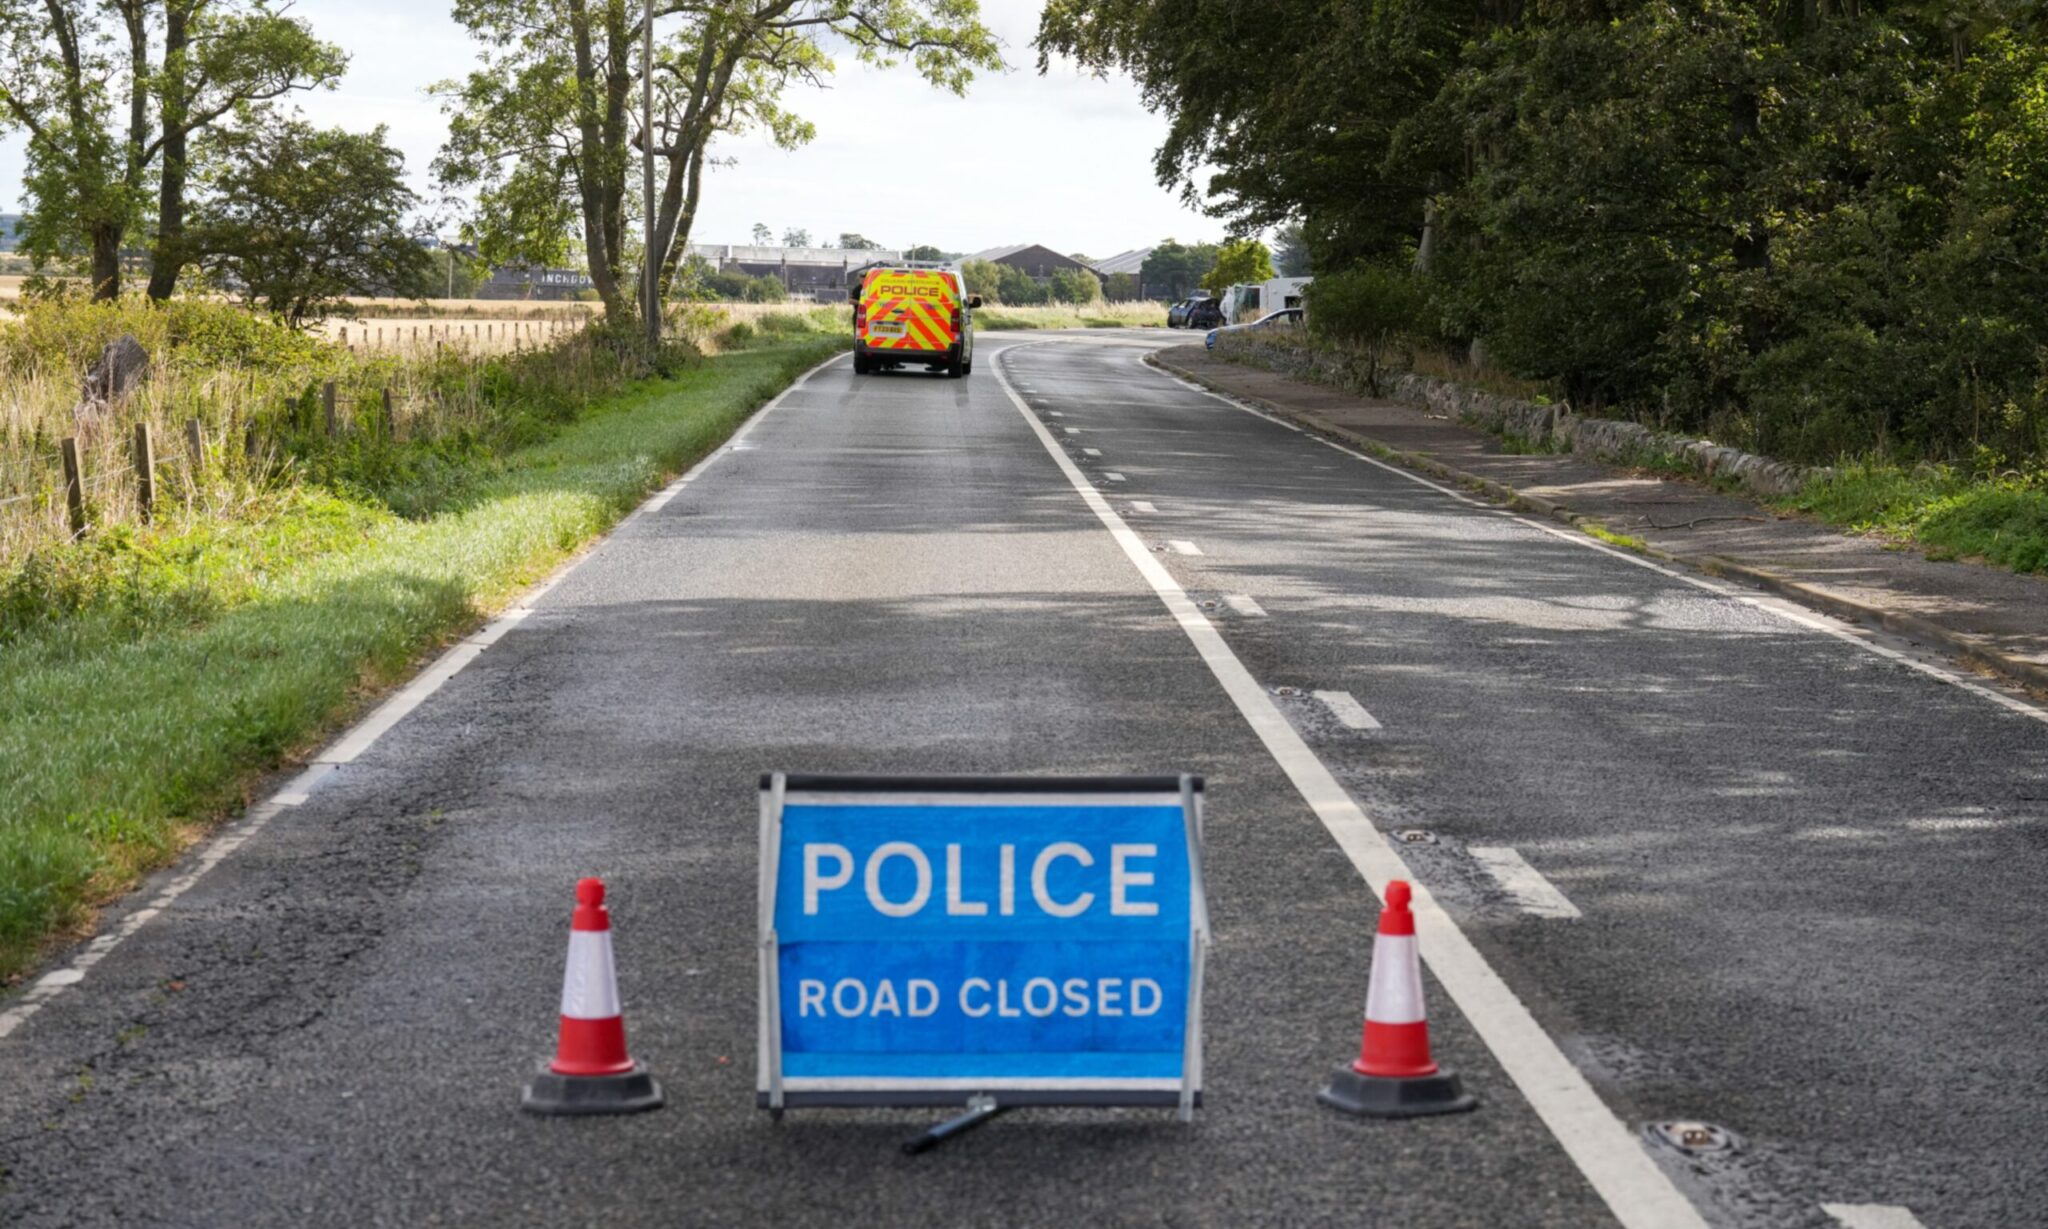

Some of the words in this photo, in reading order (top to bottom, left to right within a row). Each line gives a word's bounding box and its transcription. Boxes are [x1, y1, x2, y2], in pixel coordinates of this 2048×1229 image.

[880, 285, 939, 297] POLICE
[803, 841, 1159, 917] POLICE
[799, 978, 940, 1018] ROAD
[958, 977, 1163, 1018] CLOSED
